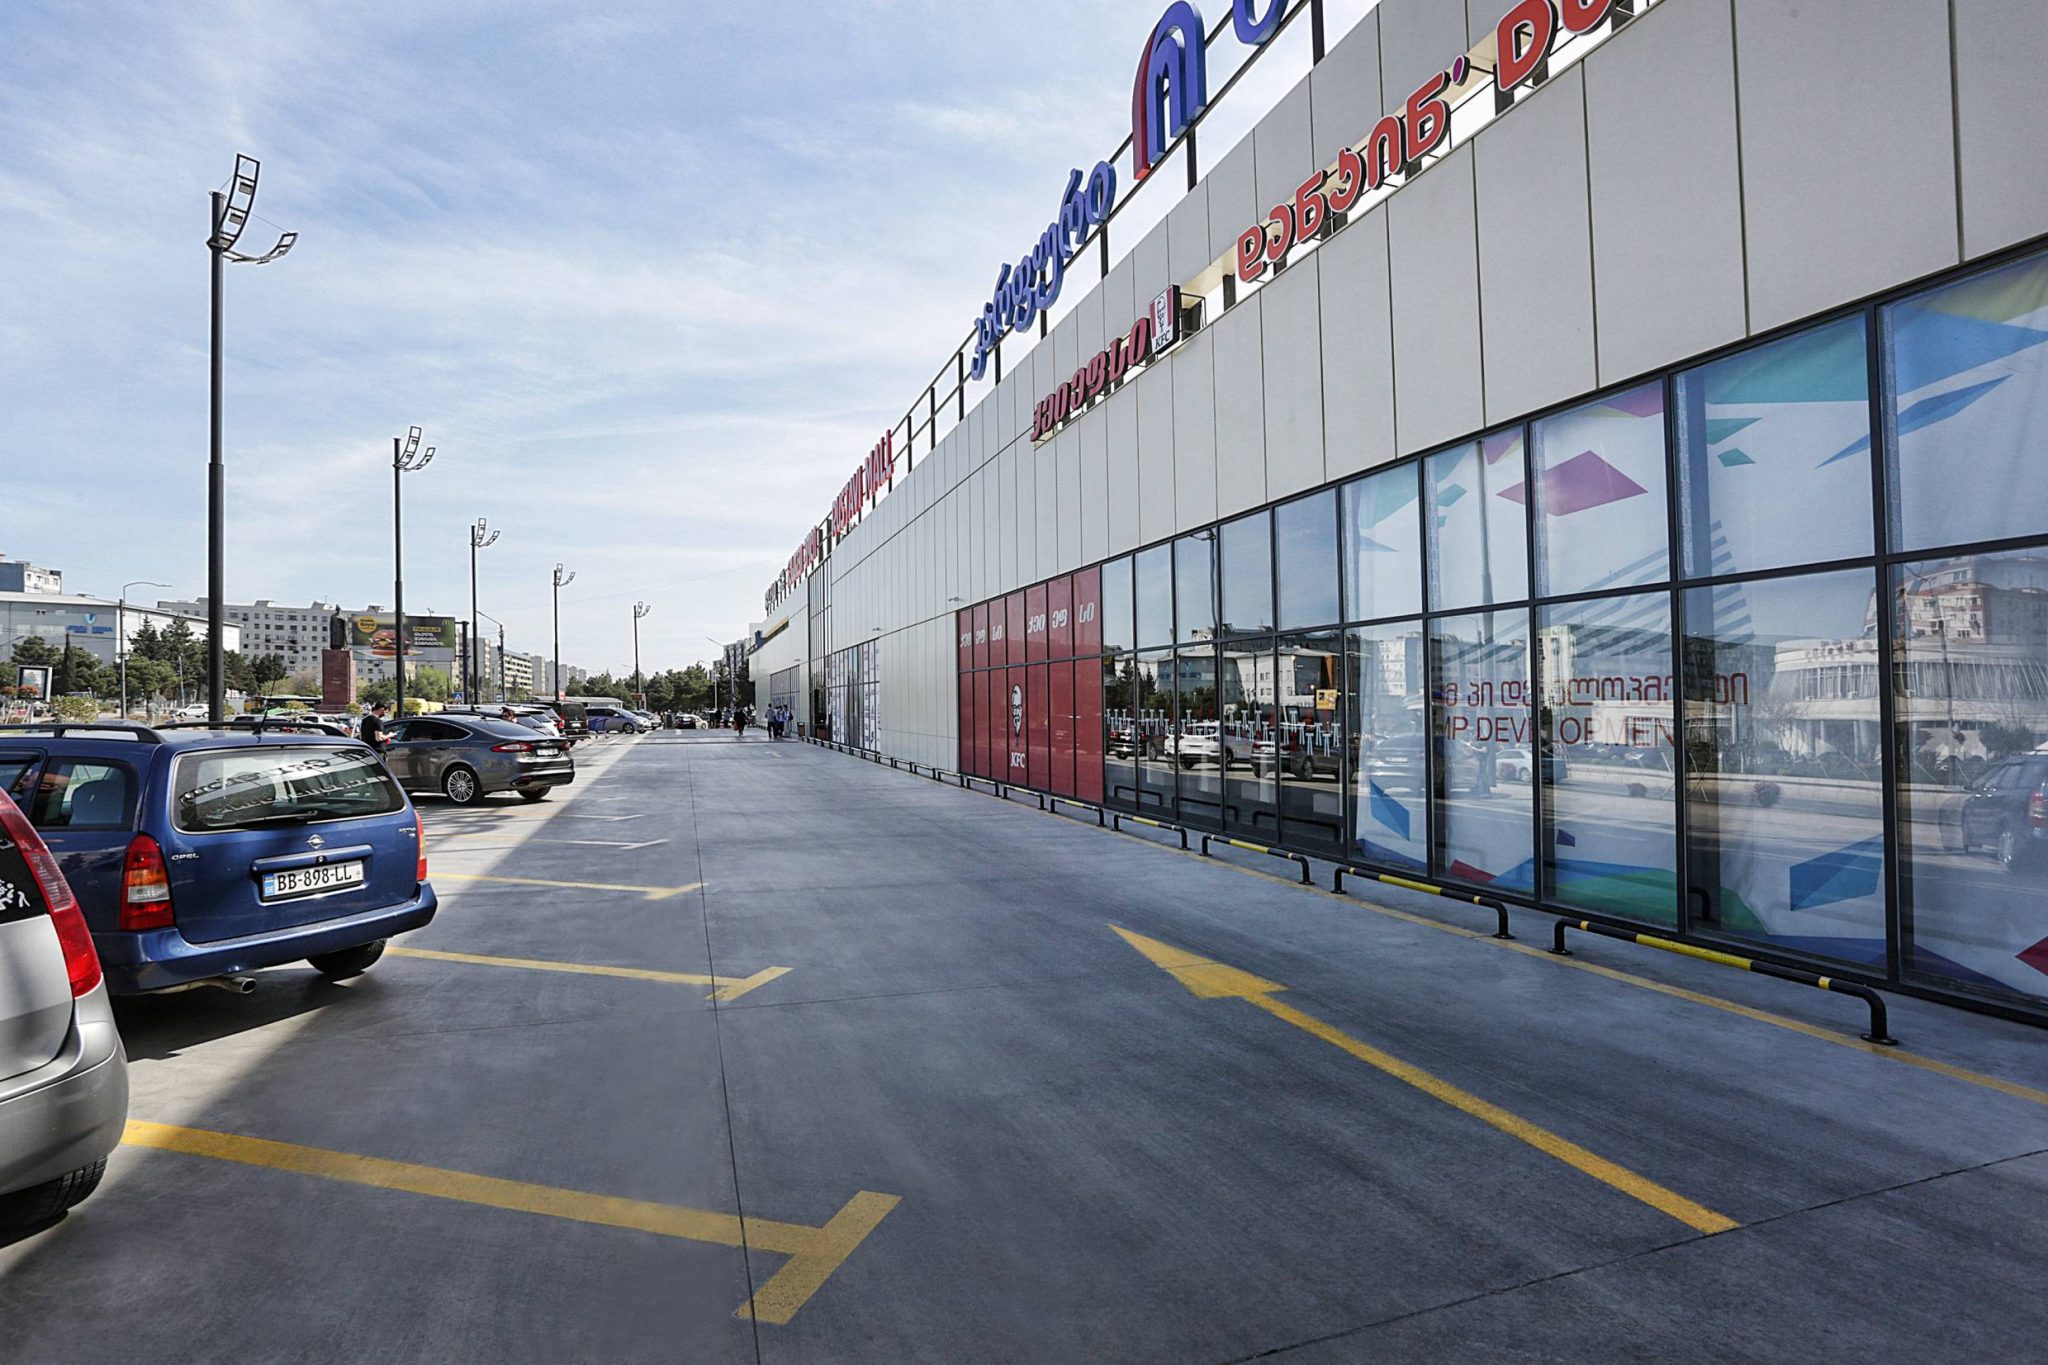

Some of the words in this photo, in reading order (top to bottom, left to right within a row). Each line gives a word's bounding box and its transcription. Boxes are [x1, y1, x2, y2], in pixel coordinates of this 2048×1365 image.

[1155, 330, 1170, 350] KFC
[832, 465, 864, 538] RUSTAVI
[865, 429, 894, 501] MALL
[1010, 751, 1026, 768] KFC
[171, 853, 200, 861] OPEL
[277, 865, 353, 892] BB-898-LL
